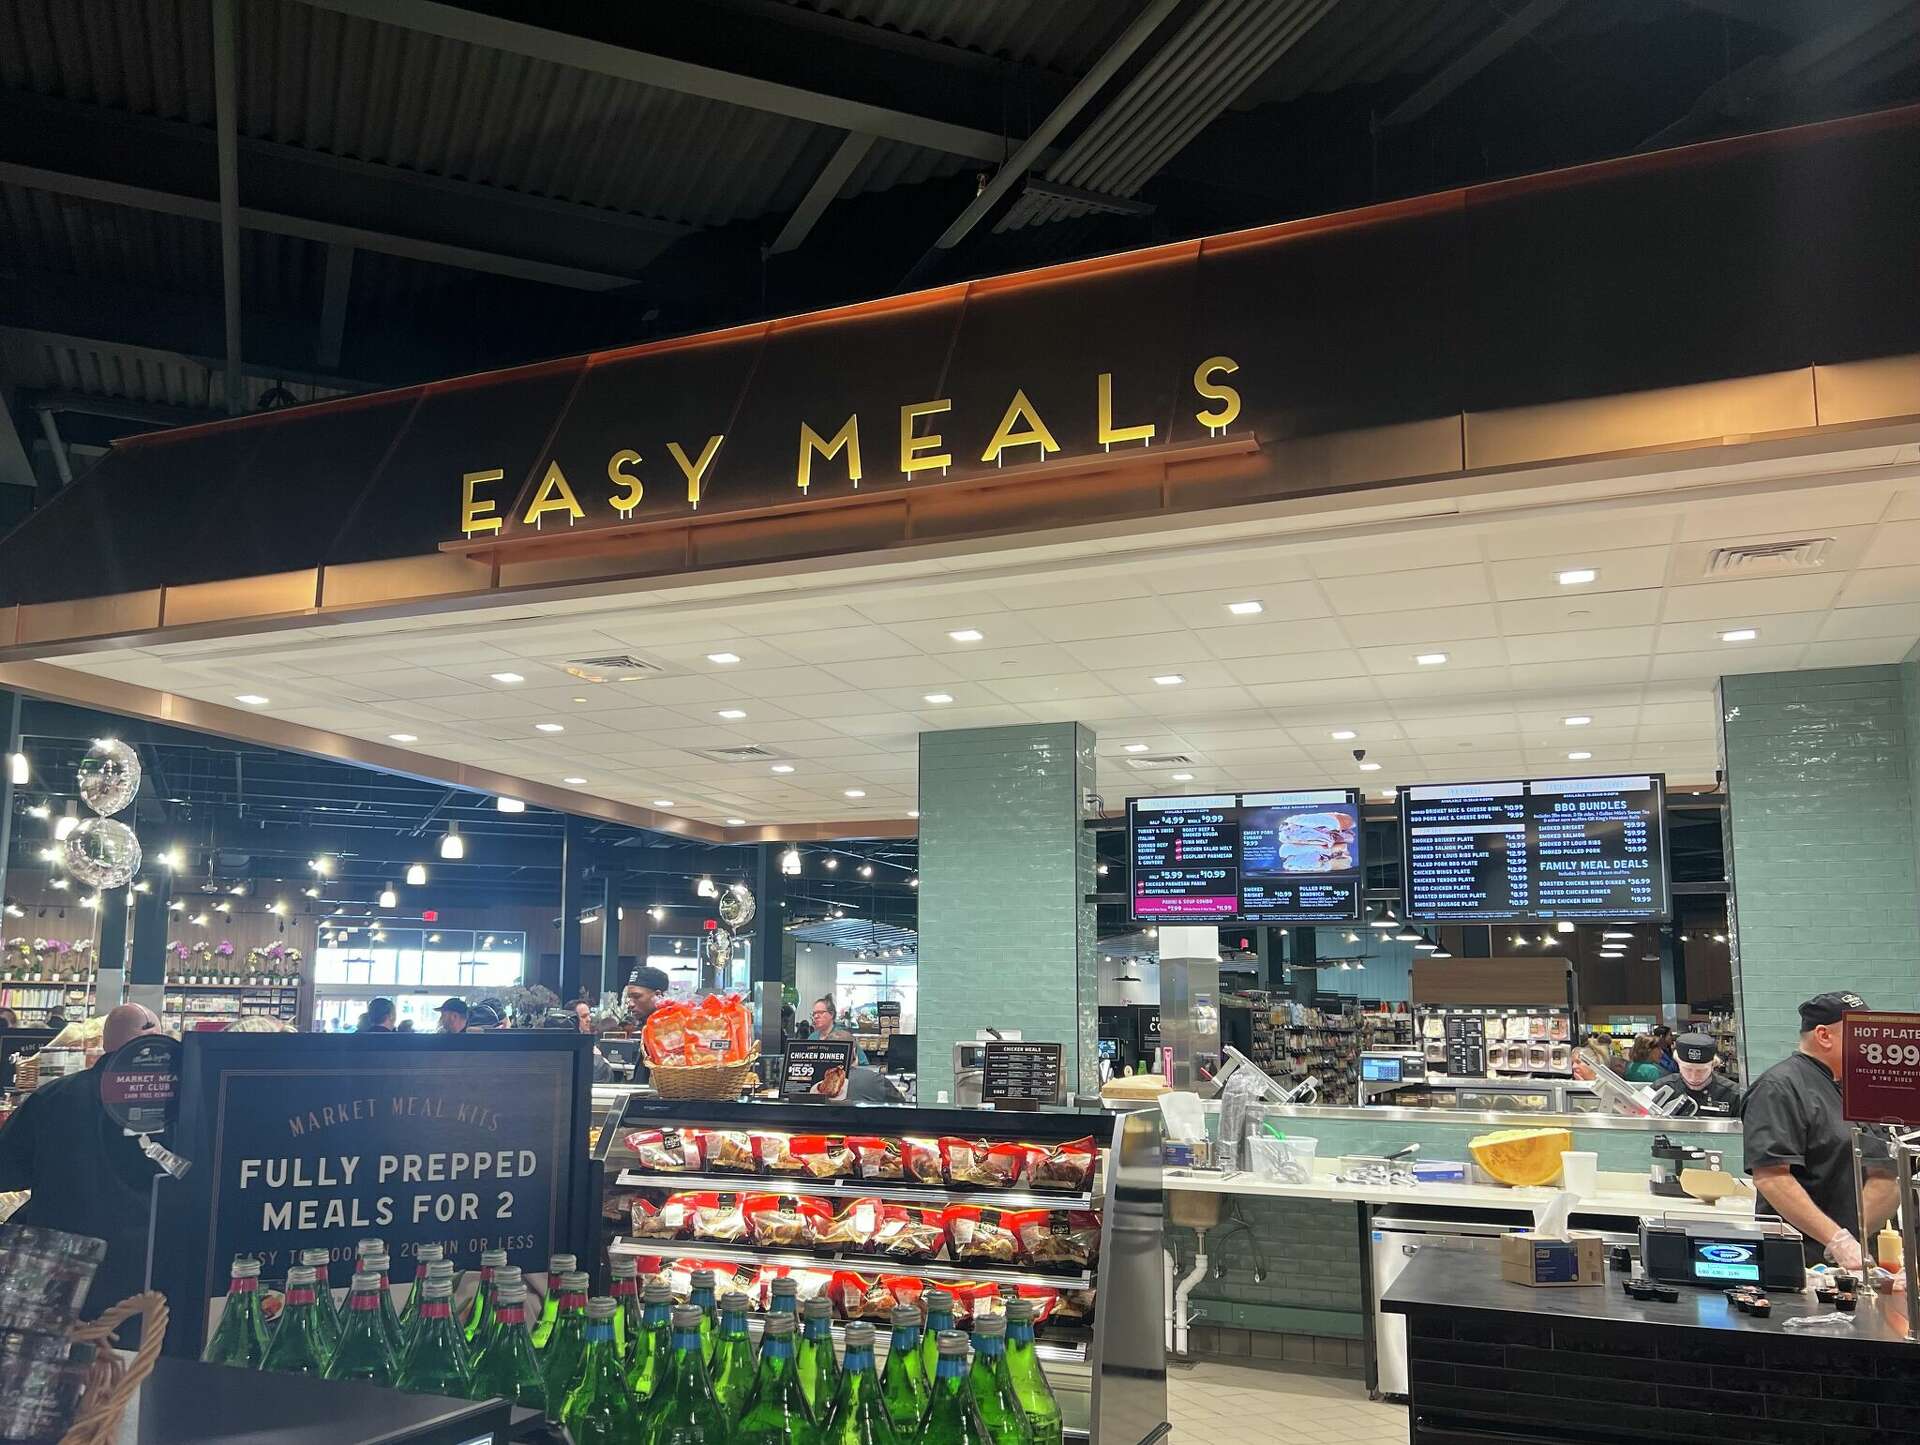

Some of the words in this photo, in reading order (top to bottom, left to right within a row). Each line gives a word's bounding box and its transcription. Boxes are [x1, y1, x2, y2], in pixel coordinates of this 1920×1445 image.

[462, 435, 724, 533] EASY
[798, 356, 1241, 485] MEALS
[1554, 803, 1576, 812] BBQ
[1579, 800, 1627, 811] BUNDLES
[1161, 816, 1185, 824] $4.99
[1201, 815, 1224, 823] $9.99
[1539, 861, 1576, 871] FAMILY
[1581, 860, 1610, 870] MEAL
[1614, 859, 1648, 868] DEALS
[1161, 871, 1183, 879] $5.99
[1854, 1027, 1879, 1038] HOT
[116, 1075, 154, 1083] MARKET
[148, 1083, 170, 1091] CLUB
[289, 1098, 376, 1137] MARKET
[392, 1097, 446, 1118] MEAL
[457, 1103, 502, 1132] KITS
[240, 1156, 360, 1189] FULLY
[378, 1150, 537, 1184] PREPPED
[262, 1196, 395, 1232] MEALS
[413, 1192, 479, 1224] FOR
[496, 1191, 514, 1219] 2
[469, 1238, 488, 1253] OR
[498, 1234, 534, 1250] LESS
